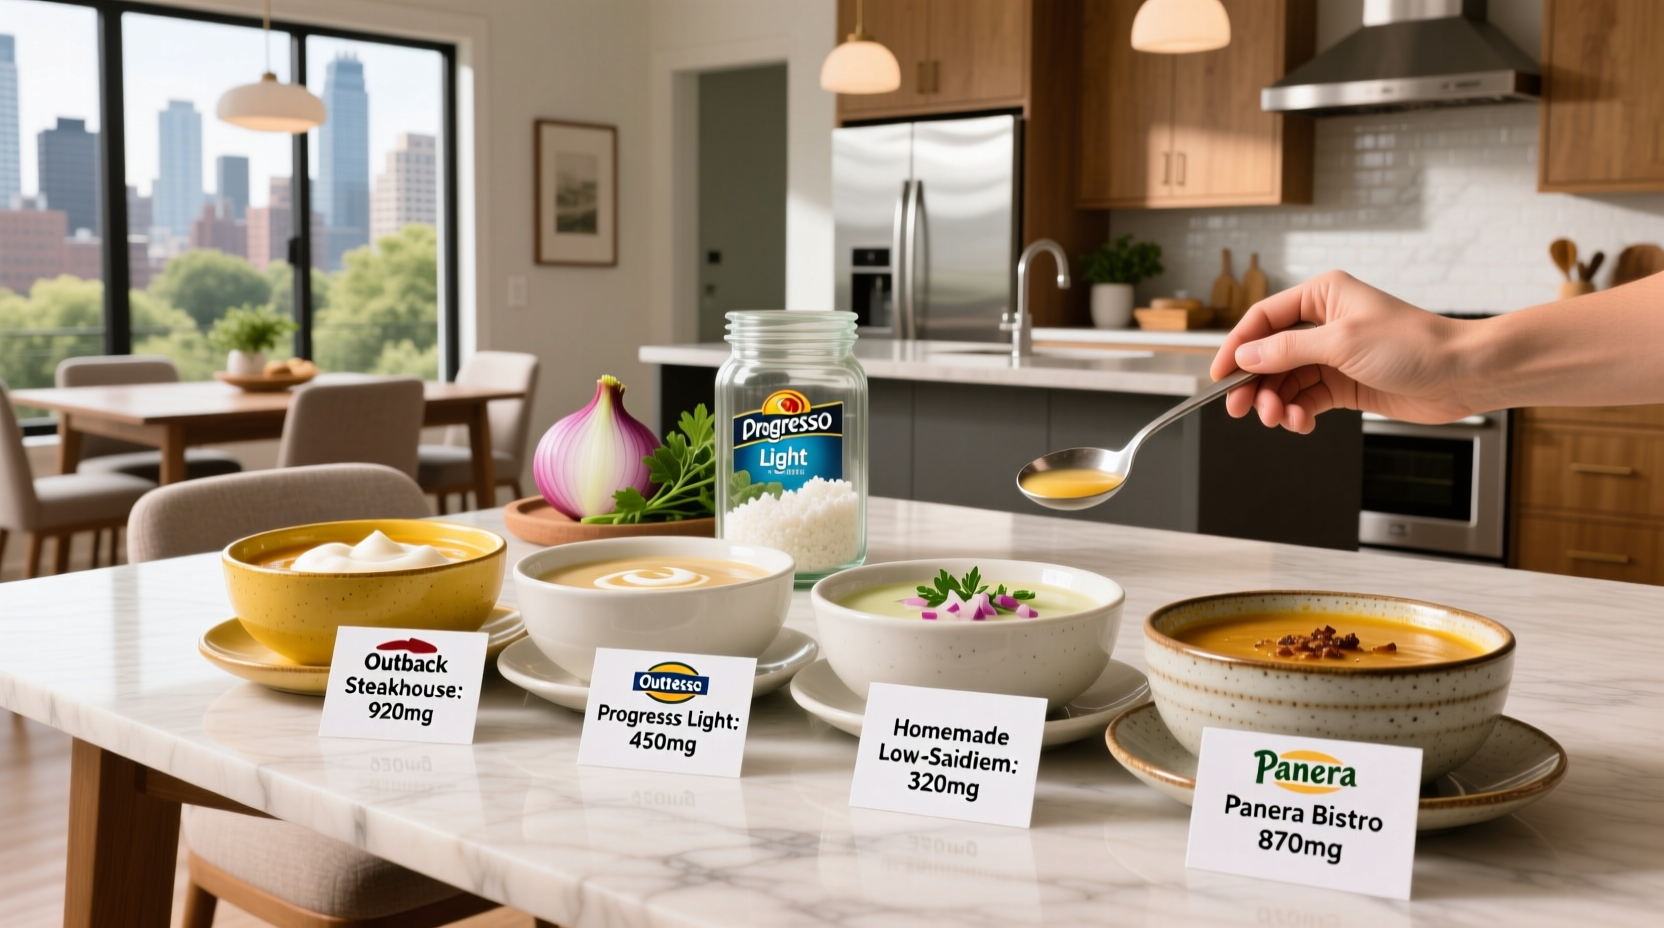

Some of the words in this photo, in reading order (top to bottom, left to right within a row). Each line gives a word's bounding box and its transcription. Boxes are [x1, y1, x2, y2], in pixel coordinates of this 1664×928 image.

[742, 412, 833, 443] Progresso
[760, 446, 808, 470] Light
[365, 653, 449, 673] Outback
[345, 676, 463, 699] Steakhouse:
[368, 701, 434, 727] 920mg
[687, 710, 739, 733] Light:
[629, 731, 697, 758] 450mg
[893, 717, 1010, 746] Homemade
[1254, 749, 1357, 787] Panera
[907, 771, 980, 803] 320mg
[1224, 793, 1304, 824] Panera
[1311, 804, 1383, 833] Bistro
[1258, 829, 1343, 865] 870mg
